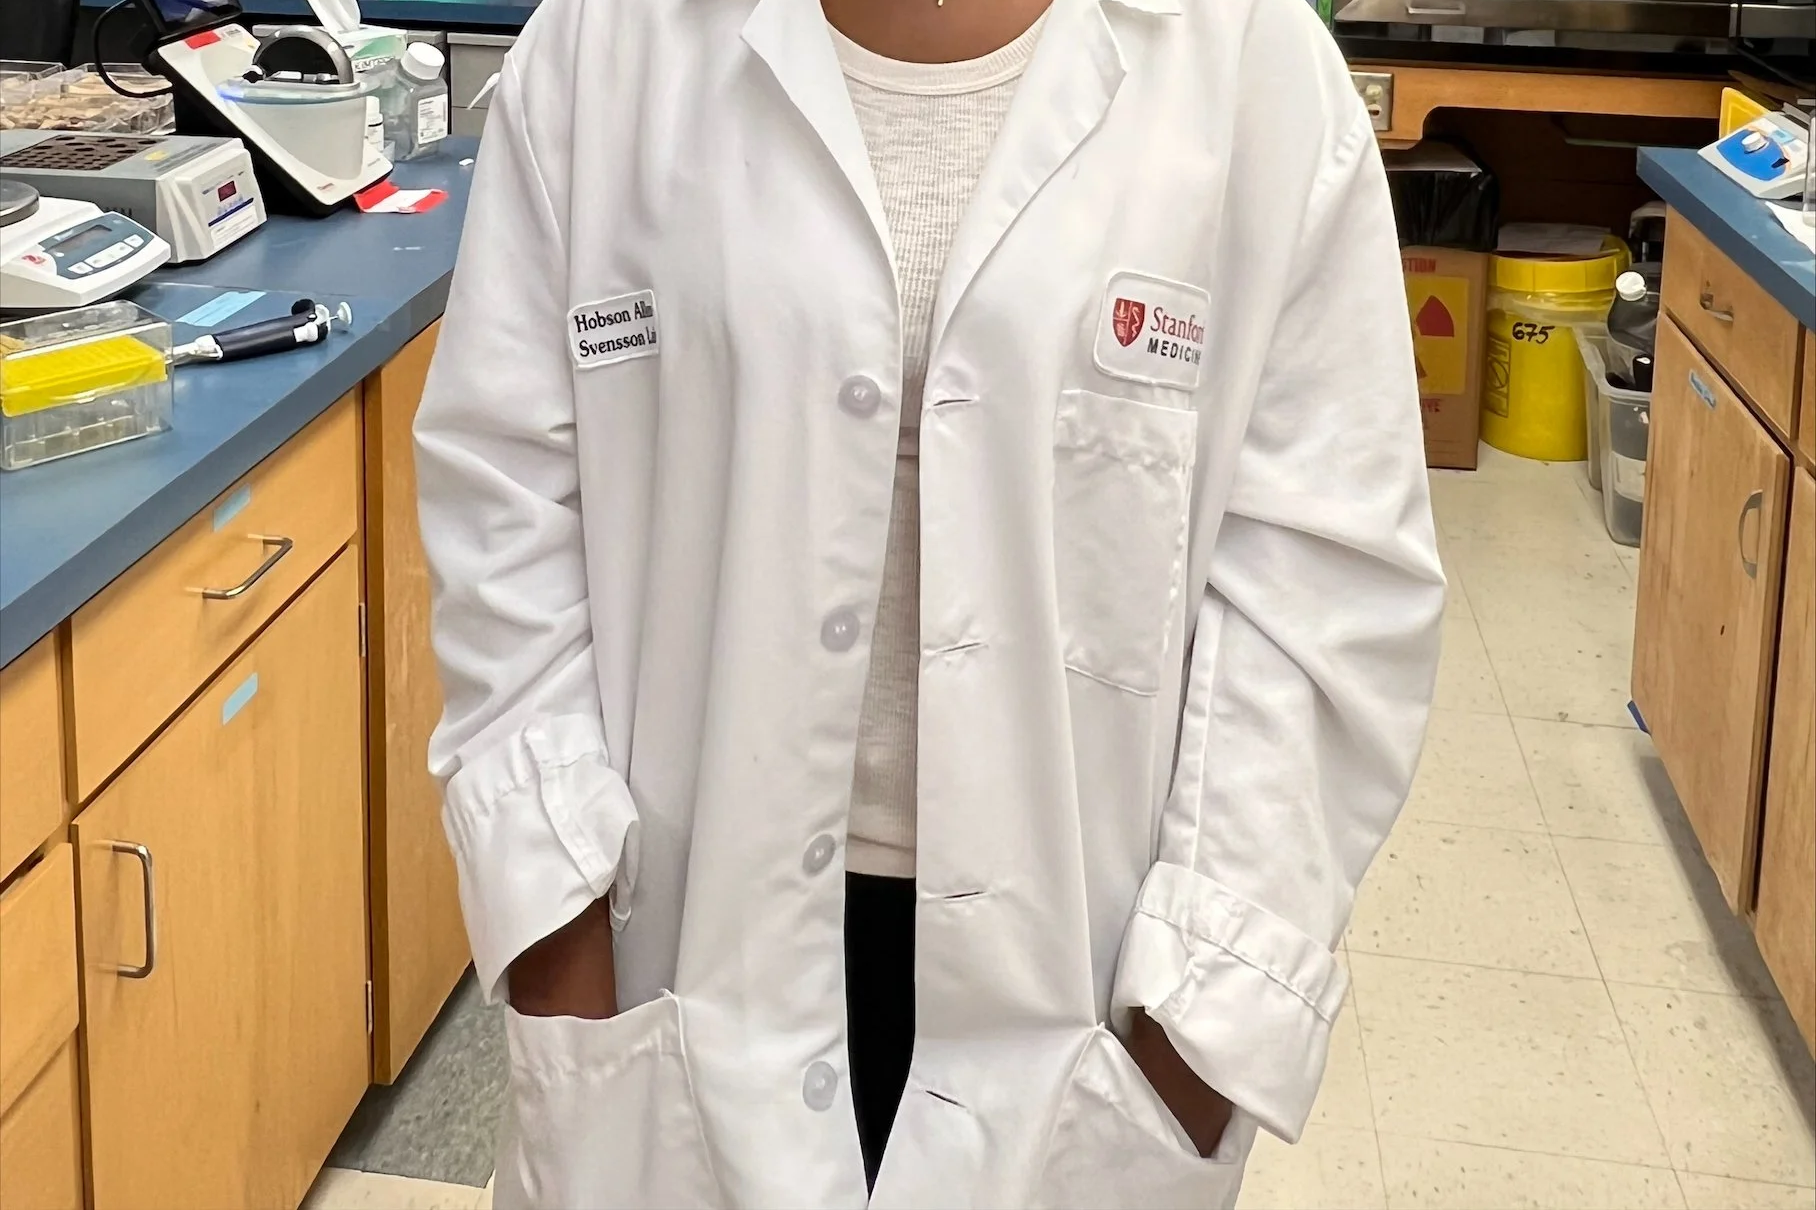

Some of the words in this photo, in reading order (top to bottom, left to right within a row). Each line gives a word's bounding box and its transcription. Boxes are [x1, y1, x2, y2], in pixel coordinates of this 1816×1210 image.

[573, 310, 632, 333] Hobson
[1512, 321, 1556, 345] 675
[579, 333, 646, 358] Svensson
